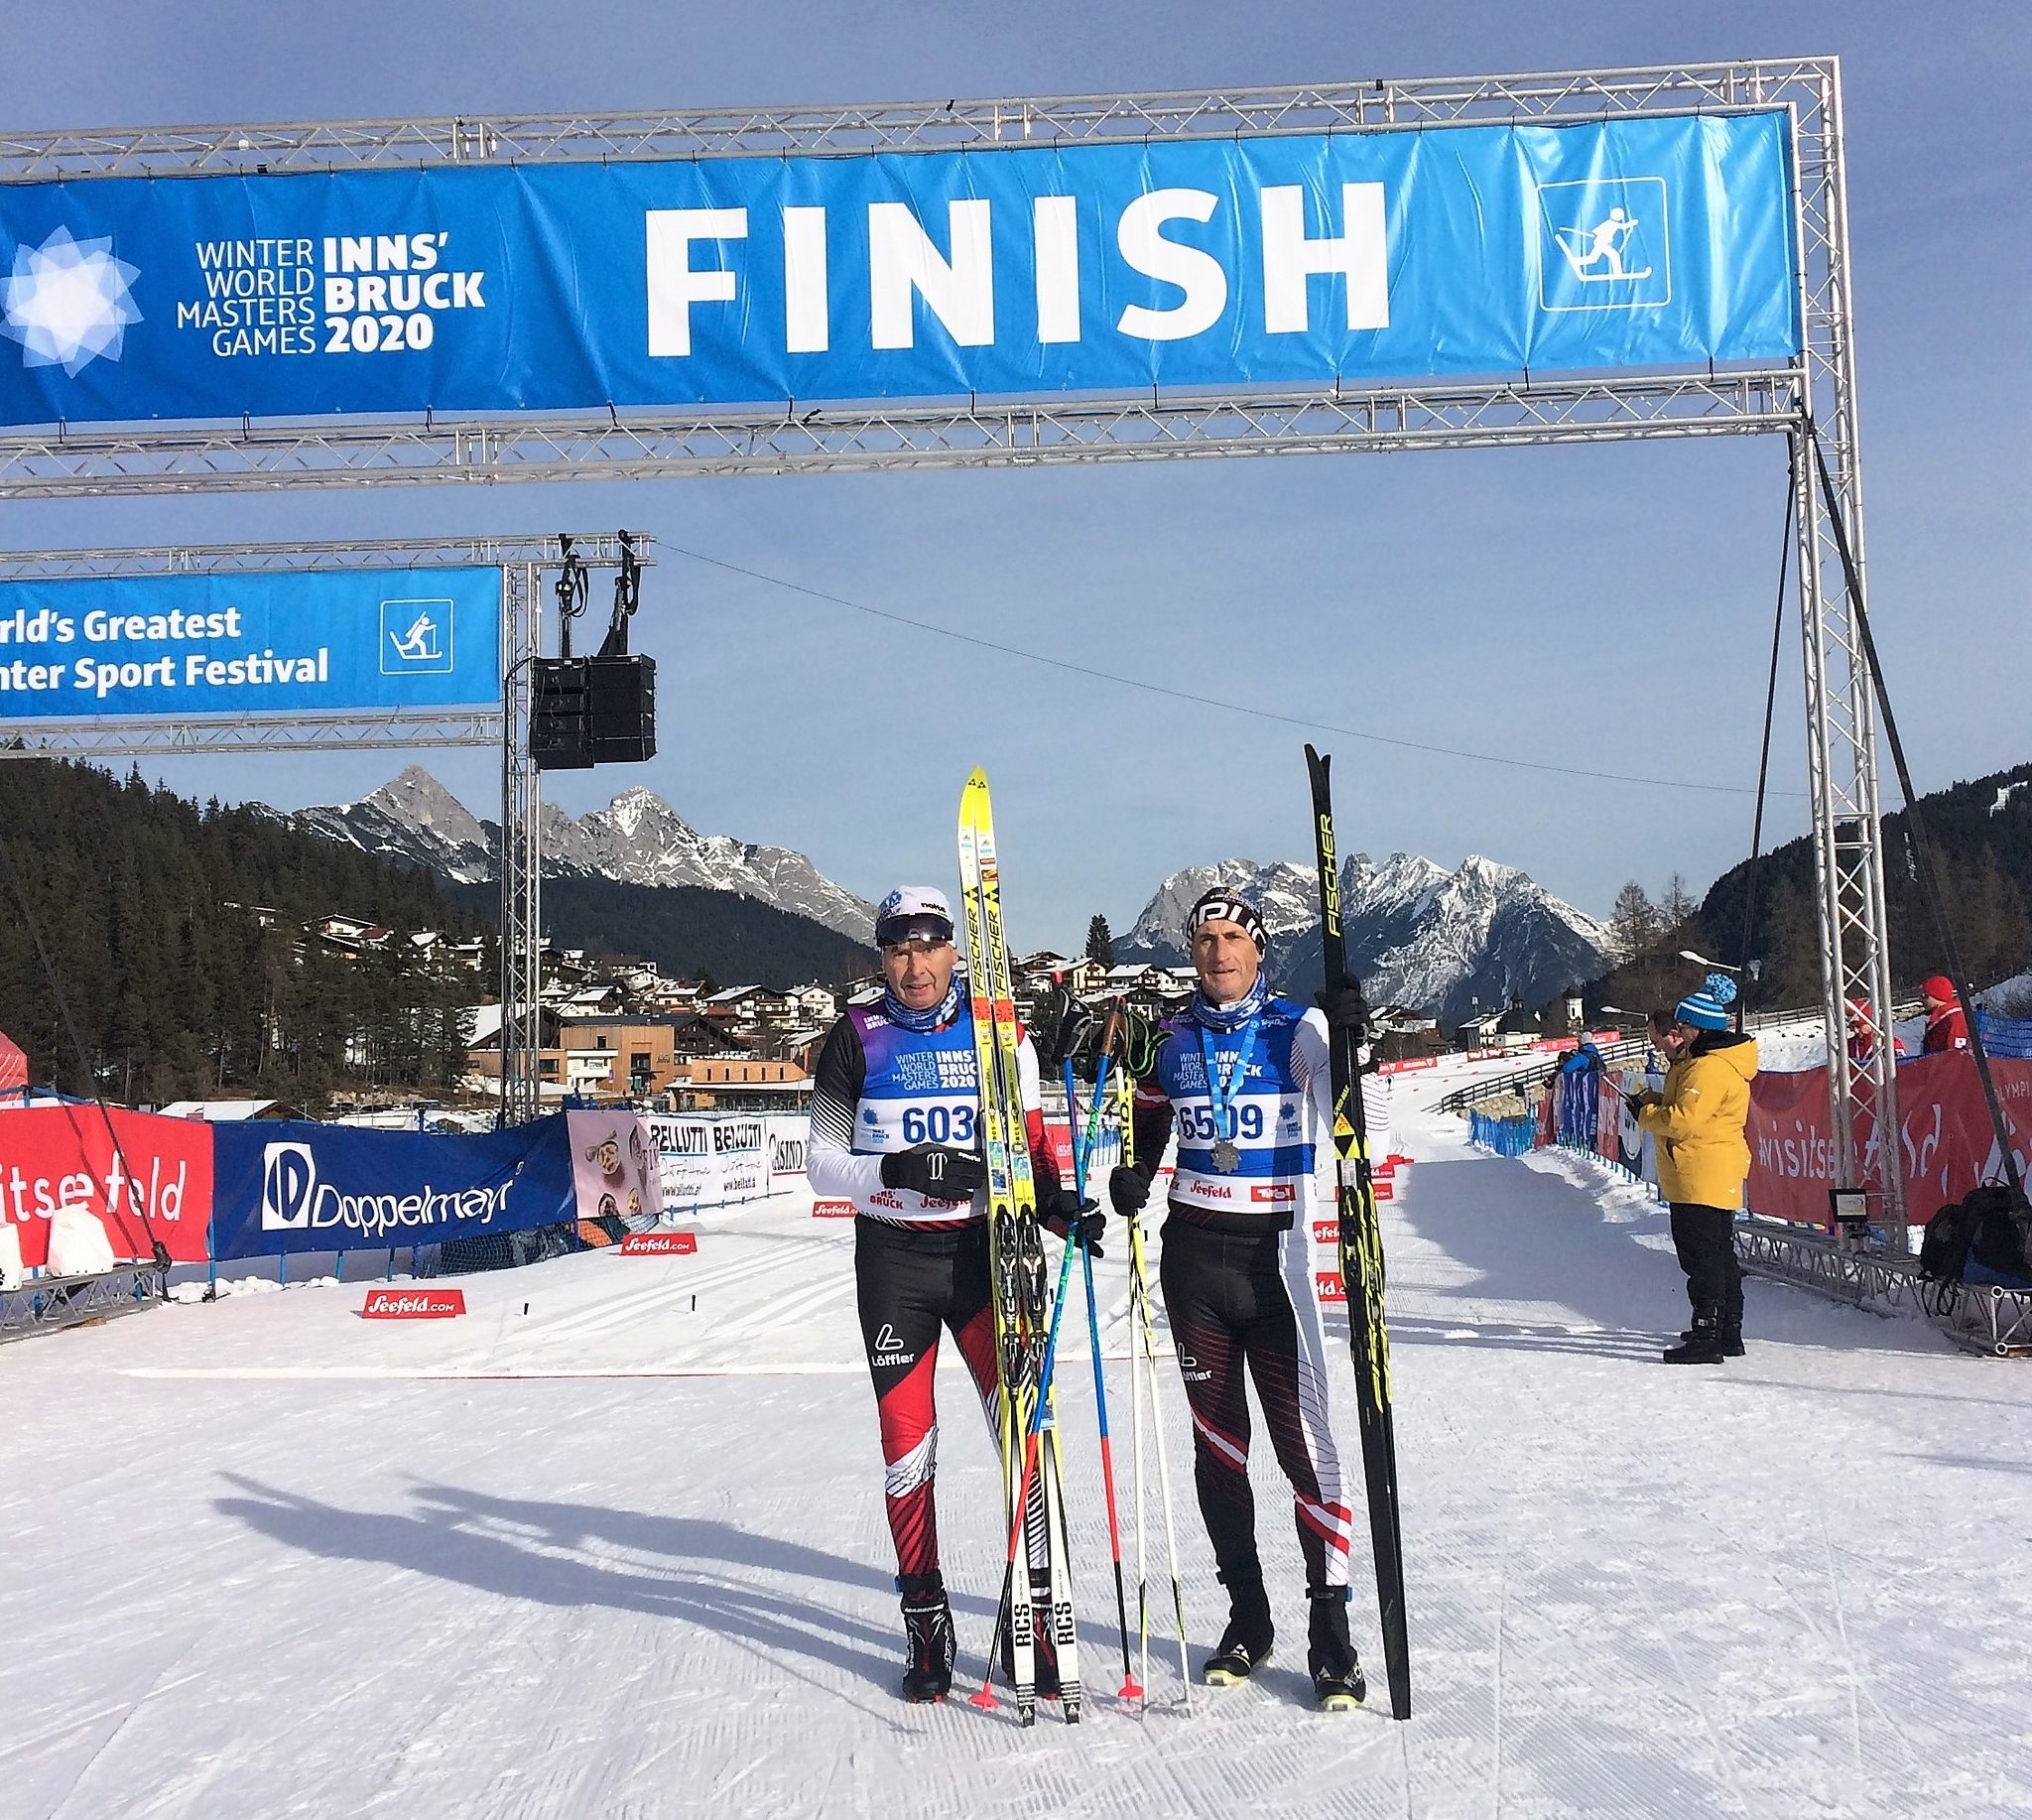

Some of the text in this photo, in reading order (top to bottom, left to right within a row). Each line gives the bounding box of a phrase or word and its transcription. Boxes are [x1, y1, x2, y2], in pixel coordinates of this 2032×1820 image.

[195, 238, 315, 268] WINTER
[645, 181, 1391, 357] FINISH
[205, 268, 316, 300] WORLD
[323, 271, 486, 314] BRUCK
[177, 297, 316, 329] MASTERS
[212, 326, 317, 357] GAMES
[323, 313, 434, 354] 2020
[83, 606, 241, 643] Greatest
[72, 656, 176, 699] Sport
[187, 647, 329, 685] Festival
[1320, 813, 1341, 938] FISCHER
[967, 907, 984, 991] FISCHER
[987, 909, 1006, 992] FISCHER
[895, 1052, 936, 1065] WINTER
[900, 1061, 937, 1073] WORLD
[937, 1062, 977, 1076] BRUC
[1179, 1052, 1206, 1063] WINTE
[892, 1070, 939, 1083] MASTERS
[904, 1079, 940, 1092] GAMES
[940, 1075, 976, 1089] 2020
[1173, 1072, 1207, 1083] MASTER
[902, 1105, 974, 1144] 603
[769, 1132, 803, 1171] CASINO
[1190, 1179, 1232, 1199] Seefeld
[311, 1179, 514, 1238] Doppelmayr
[1013, 1603, 1032, 1647] RCS
[1054, 1601, 1075, 1646] RCS
